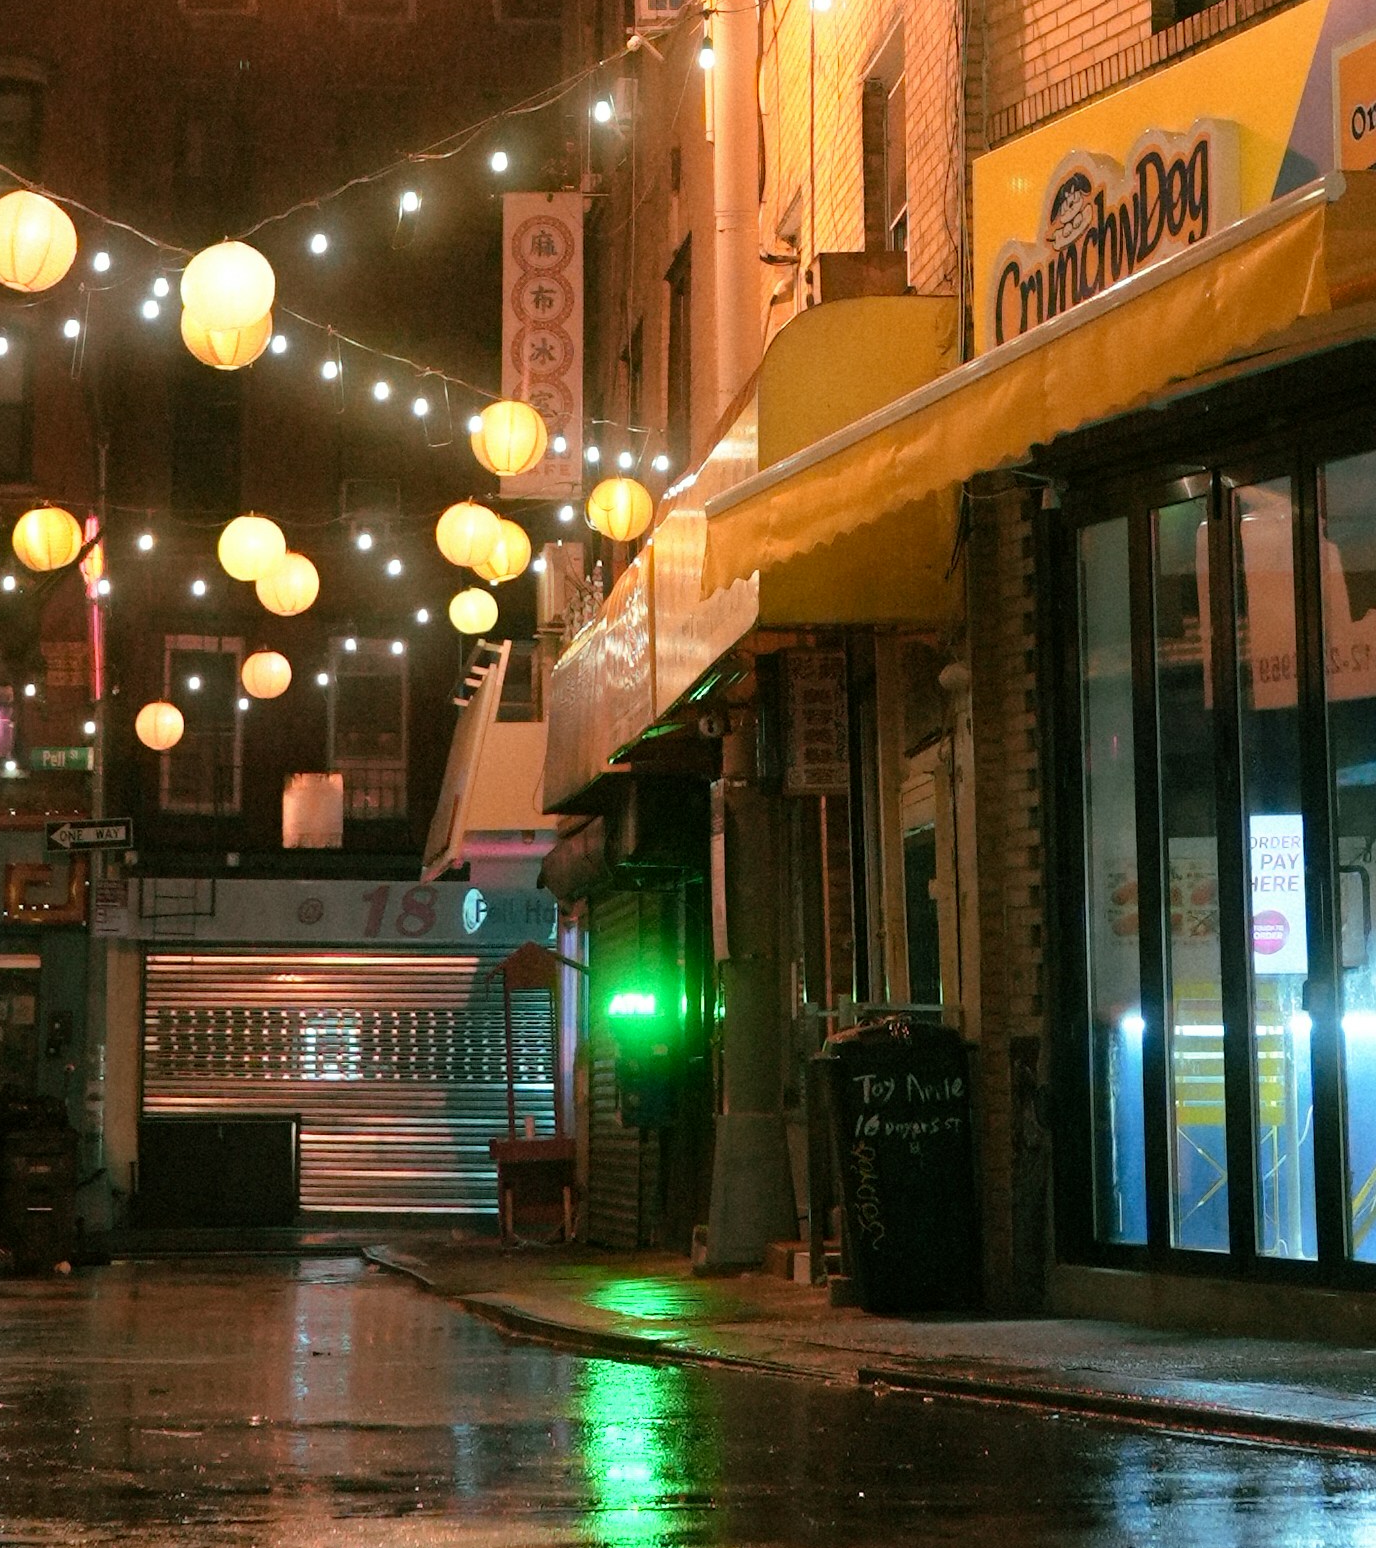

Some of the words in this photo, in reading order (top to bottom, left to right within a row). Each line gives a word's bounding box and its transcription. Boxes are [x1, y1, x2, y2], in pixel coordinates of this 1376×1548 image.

[529, 230, 559, 421] 麻布冰室
[528, 464, 572, 476] AFE
[42, 750, 66, 767] Pell
[59, 829, 84, 842] ONE
[95, 828, 120, 840] WAY
[1260, 853, 1300, 870] PAY
[362, 885, 439, 938] 18
[852, 1073, 896, 1104] Toy
